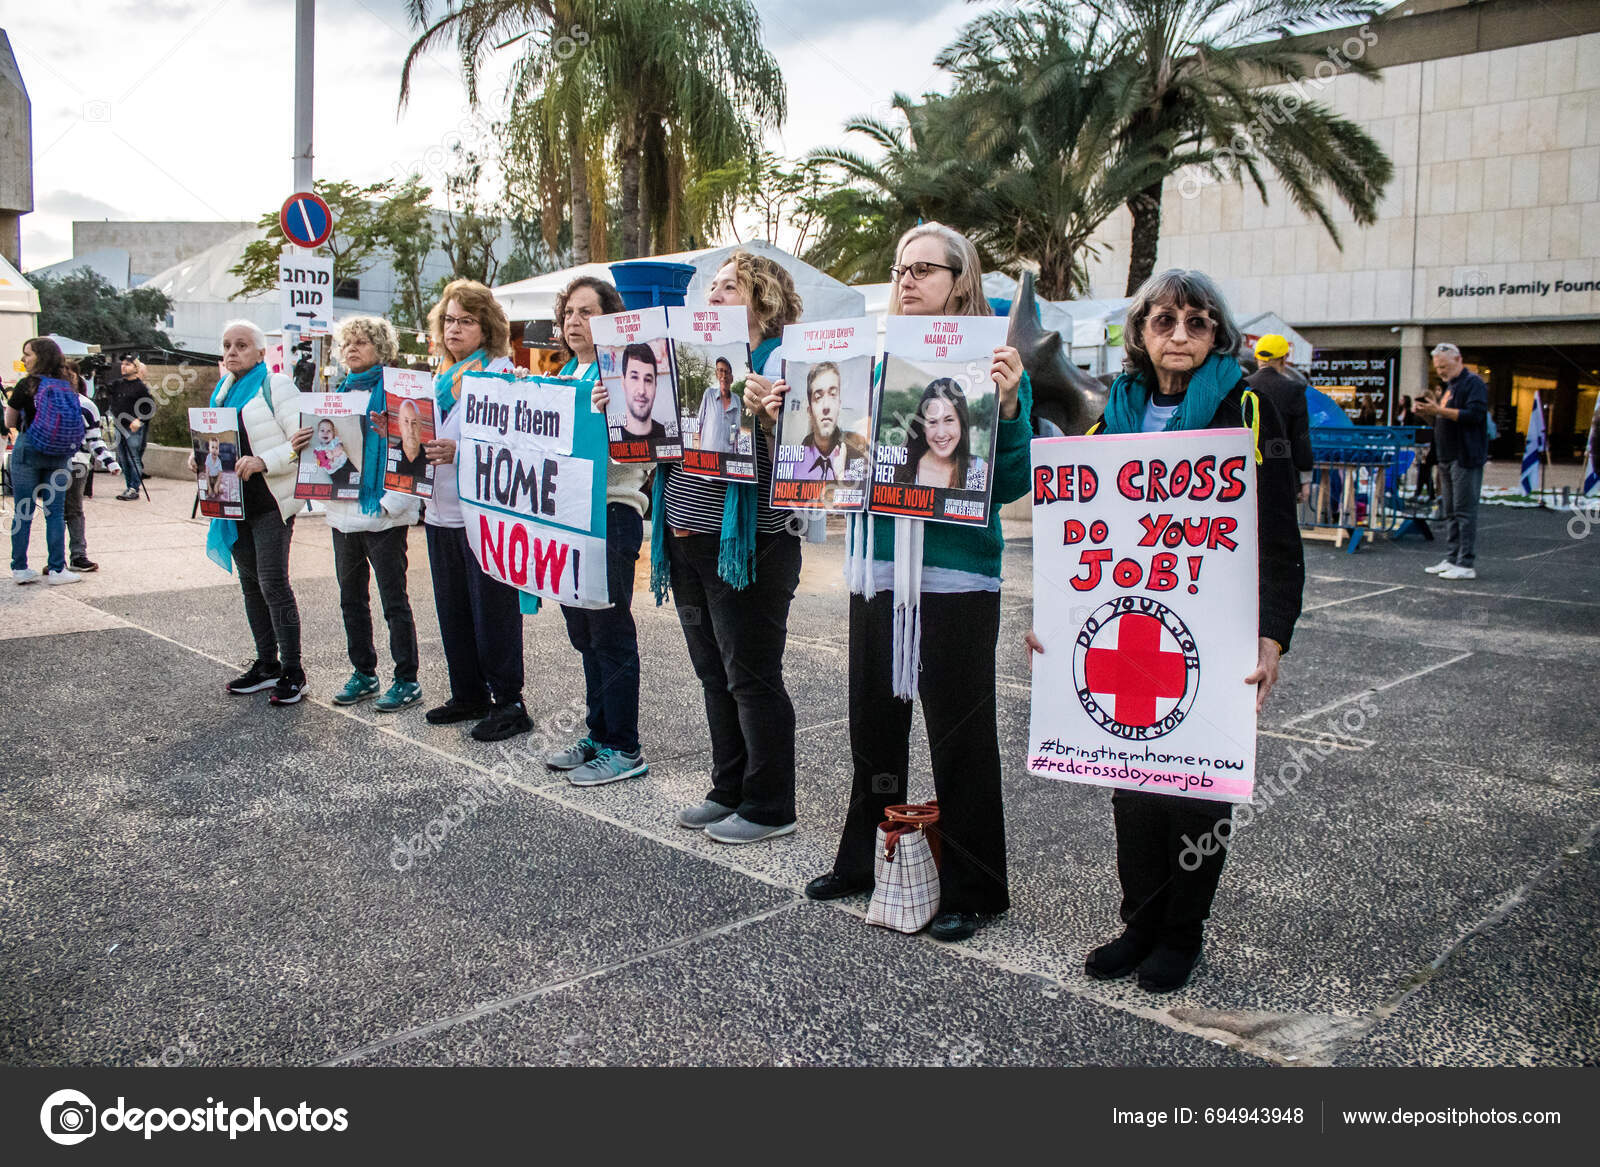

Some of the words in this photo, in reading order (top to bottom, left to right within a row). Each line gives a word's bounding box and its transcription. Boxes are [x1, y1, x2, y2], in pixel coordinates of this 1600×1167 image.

[283, 267, 329, 285] מרחב
[290, 289, 323, 308] מוגן
[1438, 283, 1495, 297] Paulson
[1499, 281, 1550, 296] Family
[924, 333, 946, 345] NAAMA
[947, 333, 963, 345] LEVY
[936, 346, 948, 358] (19)
[466, 393, 509, 435] Bring
[515, 400, 560, 438] them
[608, 412, 628, 427] BRING
[630, 440, 650, 457] NOW!
[778, 444, 805, 462] BRING
[877, 445, 908, 465] BRING
[475, 444, 558, 516] HOME
[776, 463, 795, 480] HIM
[874, 464, 896, 484] HER
[1033, 465, 1099, 505] RED
[1117, 455, 1247, 503] CROSS
[774, 482, 800, 499] HOME
[800, 480, 826, 501] NOW!
[873, 485, 902, 505] HOME
[904, 488, 935, 509] NOW!
[1063, 519, 1109, 546] DO
[1137, 513, 1239, 552] YOUR
[480, 514, 580, 600] NOW!
[1069, 548, 1204, 595] JOB!
[1077, 617, 1100, 649] DO
[1105, 596, 1170, 624] YOUR
[1171, 619, 1199, 670] JOB
[1078, 688, 1097, 713] DO
[1100, 713, 1148, 739] YOUR
[1152, 708, 1185, 736] JOB
[1031, 755, 1214, 792] #redcrossdoyourjob
